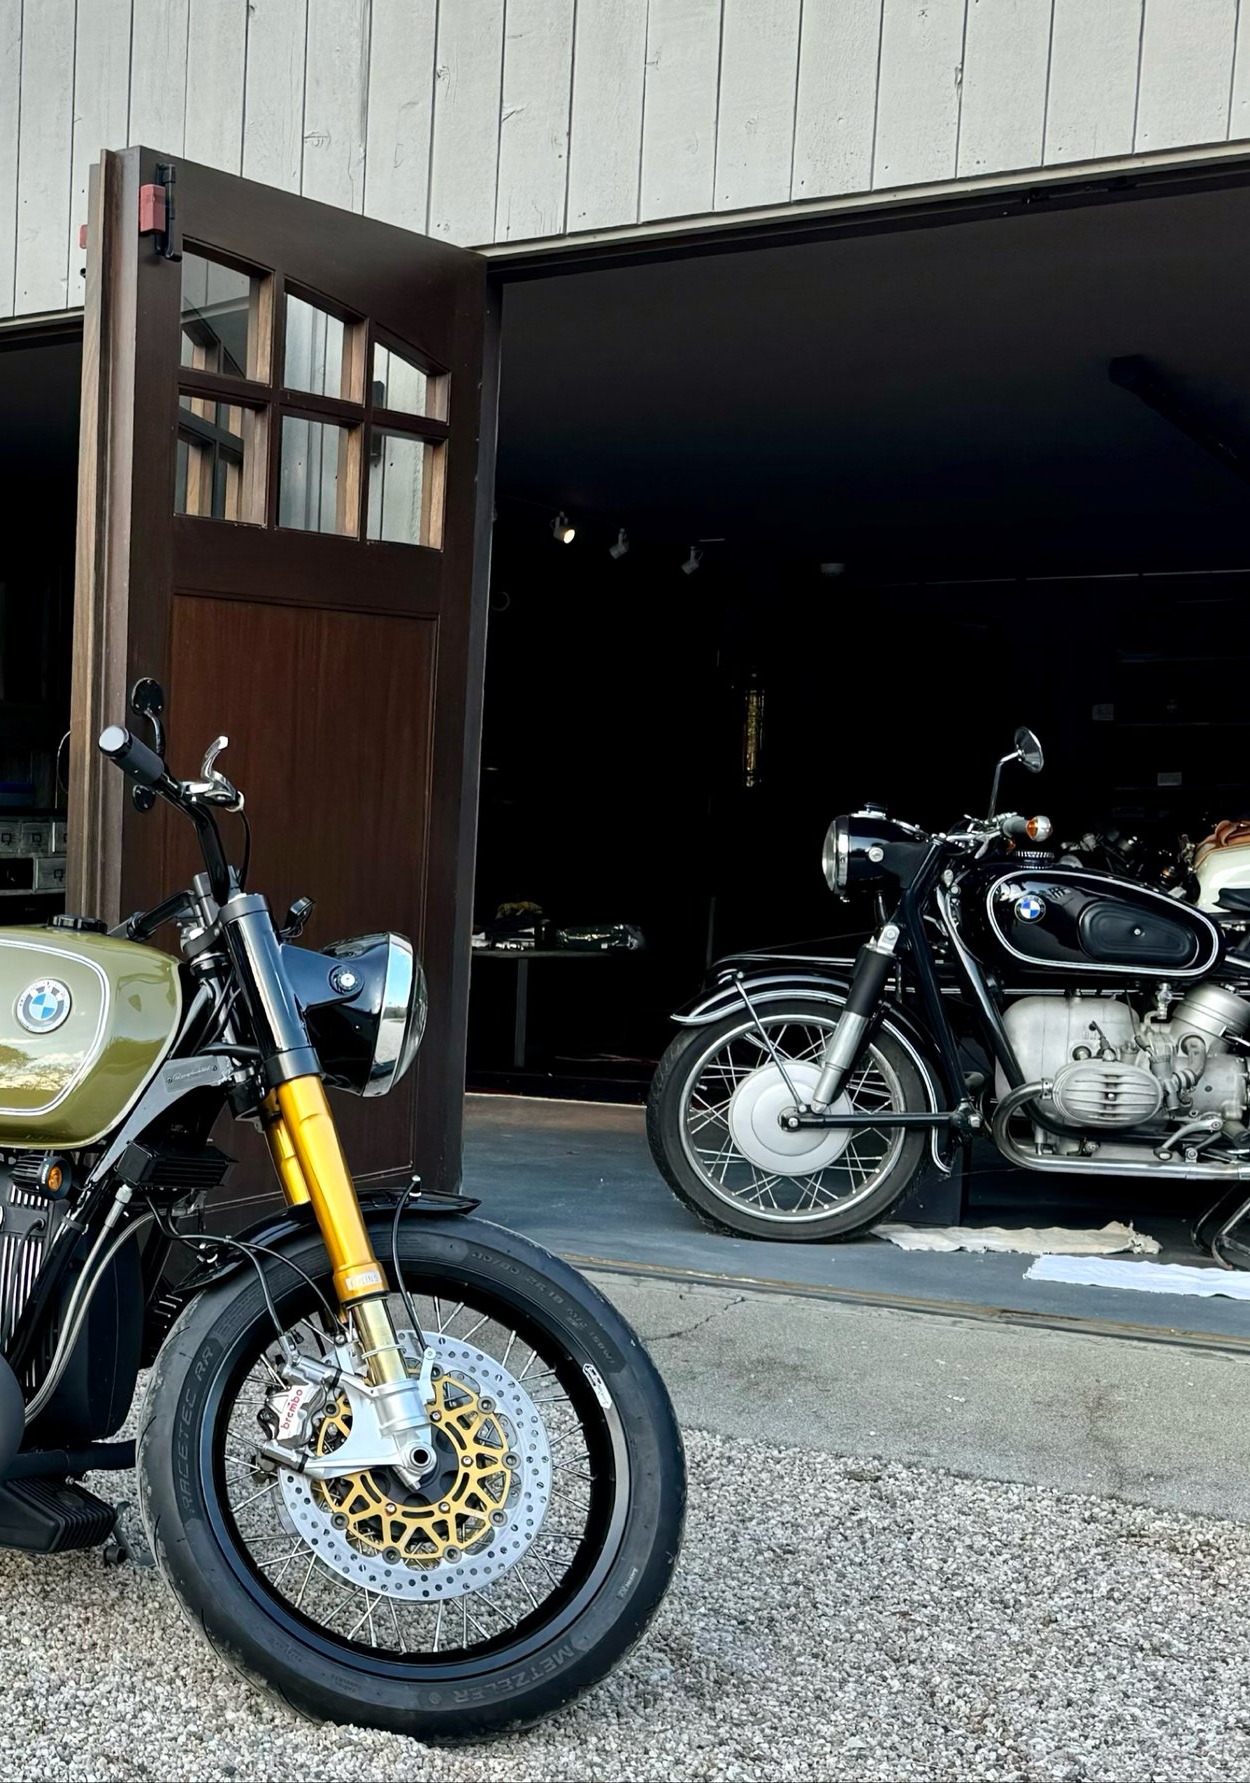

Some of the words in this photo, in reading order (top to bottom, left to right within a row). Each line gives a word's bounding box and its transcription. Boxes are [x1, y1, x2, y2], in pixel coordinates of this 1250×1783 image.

[177, 1387, 197, 1514] RACETEC
[194, 1346, 214, 1382] RR
[280, 1389, 303, 1430] brembo
[453, 1643, 576, 1704] METZELER
